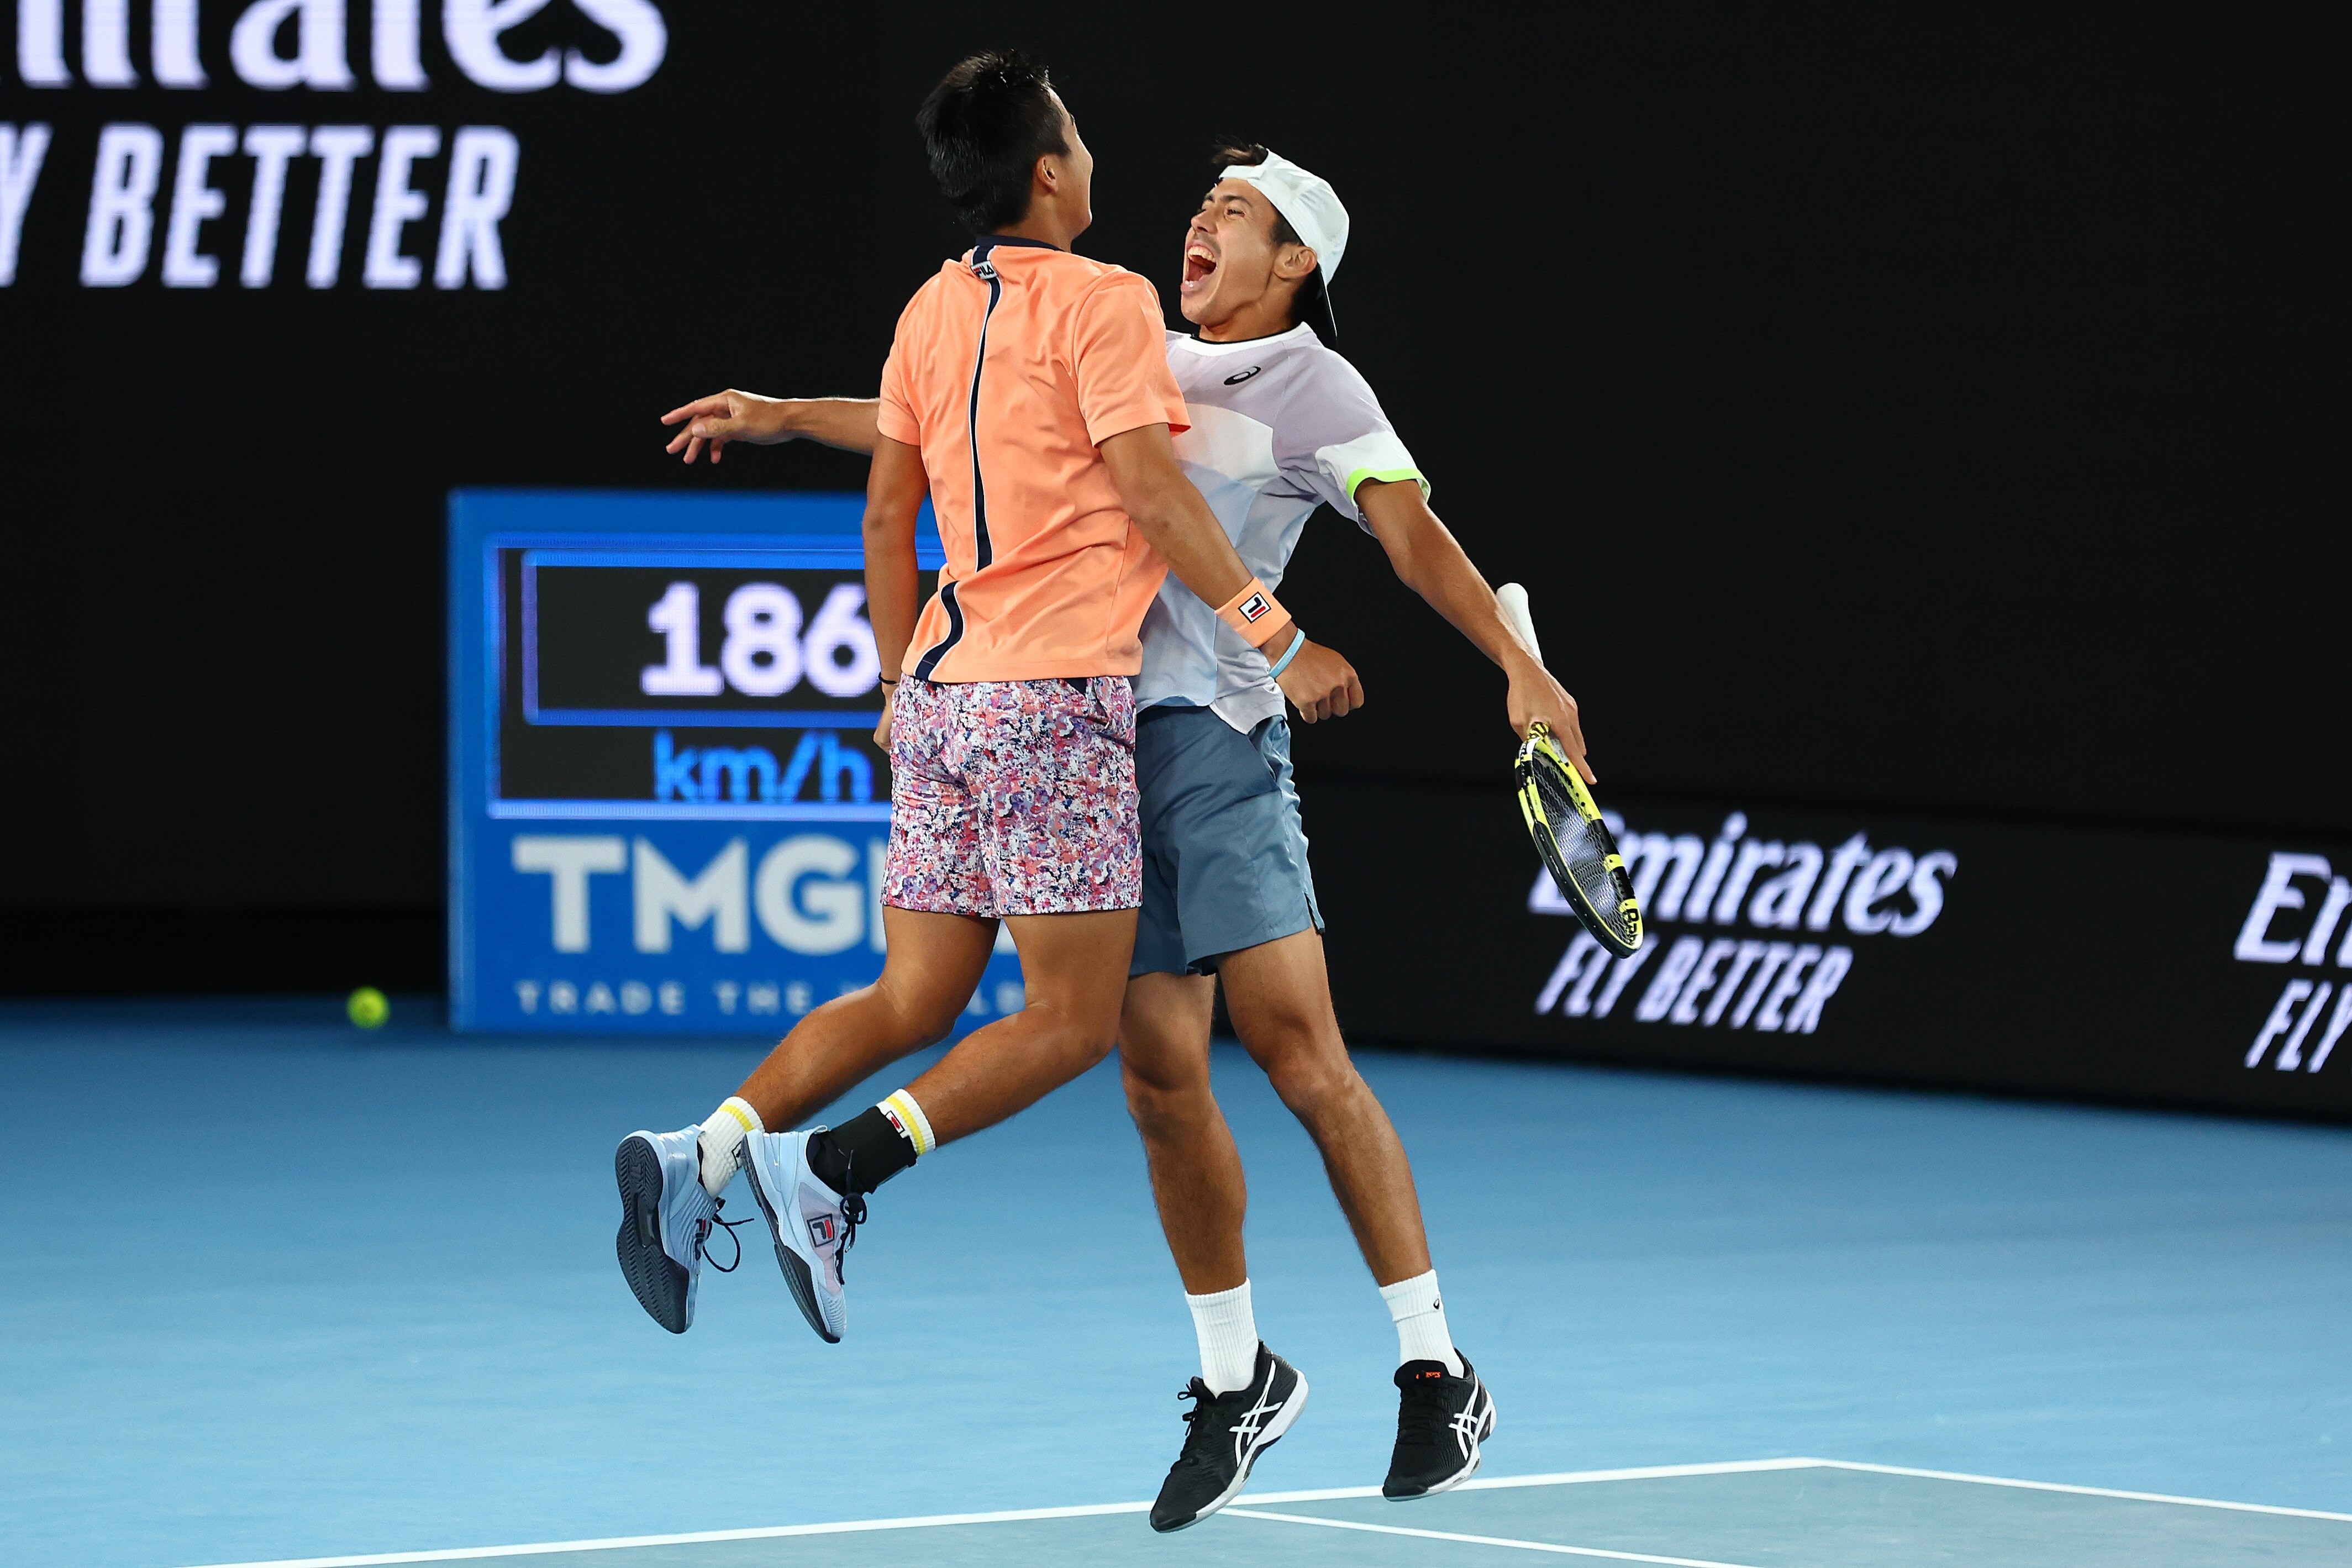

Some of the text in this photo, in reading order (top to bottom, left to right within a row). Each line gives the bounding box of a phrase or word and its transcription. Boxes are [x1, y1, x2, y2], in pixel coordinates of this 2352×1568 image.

[80, 123, 520, 291] BETTER
[973, 264, 995, 278] FILA
[639, 581, 880, 697] 186
[654, 732, 872, 802] km/h
[513, 835, 887, 955] TMG
[516, 980, 812, 1016] TRADE THE
[1634, 934, 1854, 1035] BETTER
